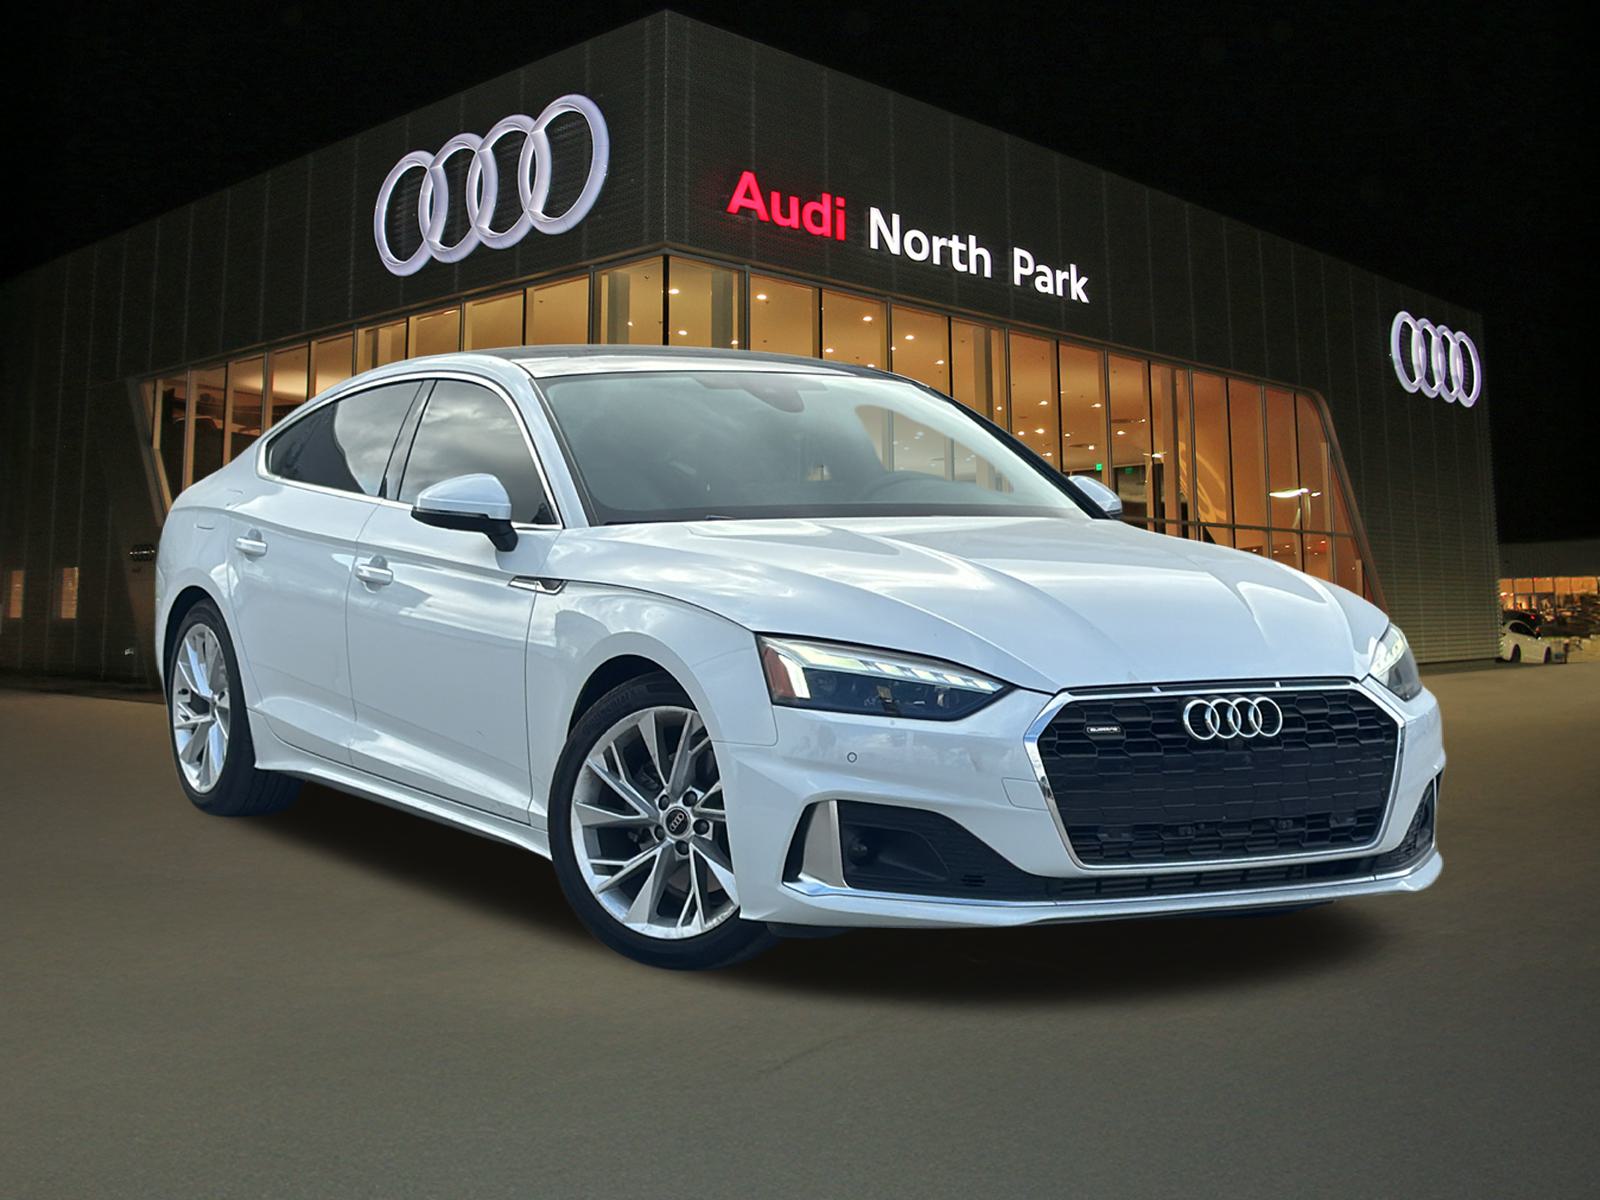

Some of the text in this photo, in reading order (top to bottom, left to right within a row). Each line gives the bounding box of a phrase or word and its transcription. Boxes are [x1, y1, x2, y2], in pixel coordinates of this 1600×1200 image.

[727, 171, 1090, 304] Audi North Park
